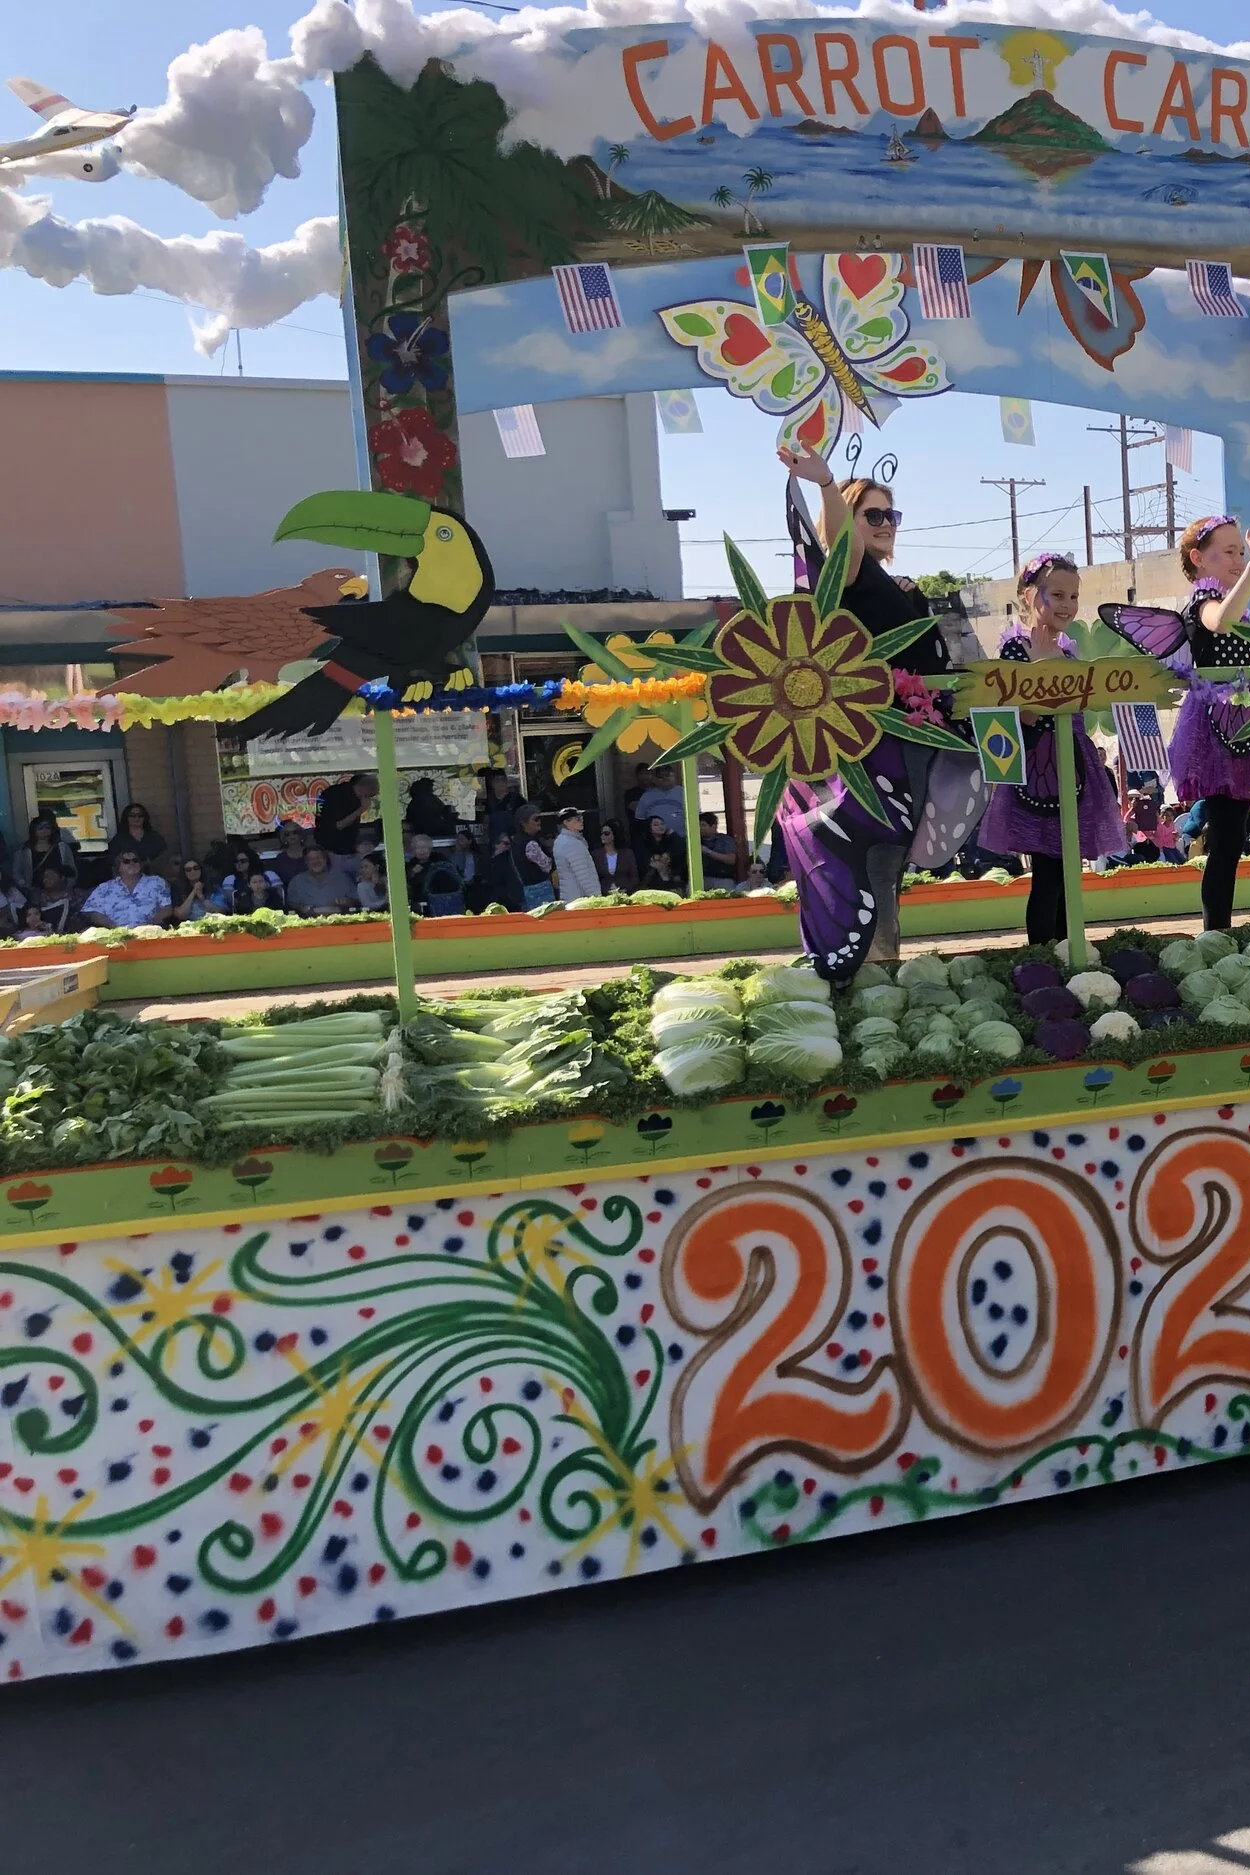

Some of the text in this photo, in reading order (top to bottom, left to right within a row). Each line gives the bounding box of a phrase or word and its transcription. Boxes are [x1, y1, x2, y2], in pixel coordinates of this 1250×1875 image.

[622, 32, 980, 142] CARROT
[984, 666, 1096, 710] Vessey
[36, 771, 60, 781] 102A
